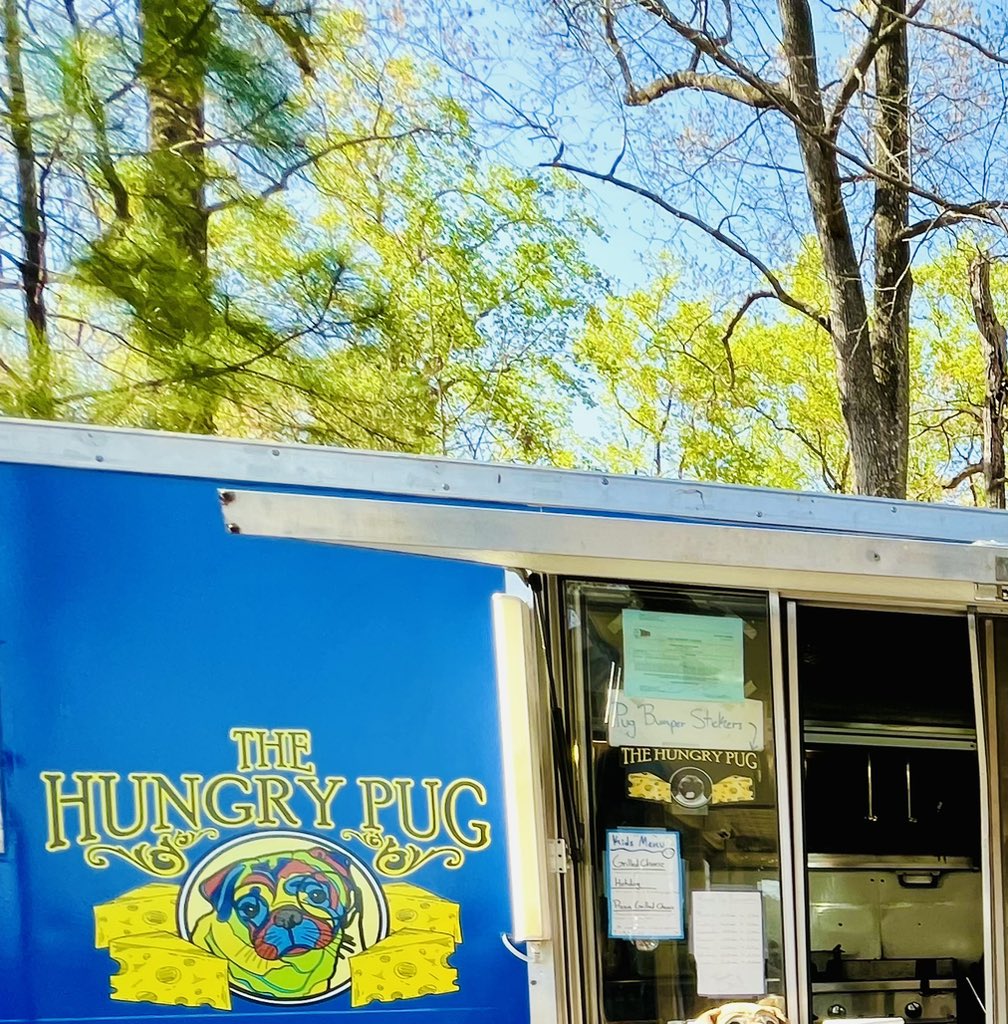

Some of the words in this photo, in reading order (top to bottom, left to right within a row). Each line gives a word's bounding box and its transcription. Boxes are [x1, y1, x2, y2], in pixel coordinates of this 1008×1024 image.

[637, 703, 686, 734] Bumper
[230, 728, 315, 775] THE
[620, 747, 652, 765] THE
[655, 748, 724, 764] HUNGRY
[725, 752, 758, 769] PUG
[41, 772, 346, 853] HUNGRY
[358, 776, 492, 851] PUG
[612, 834, 634, 847] Kids
[639, 836, 665, 848] Menu
